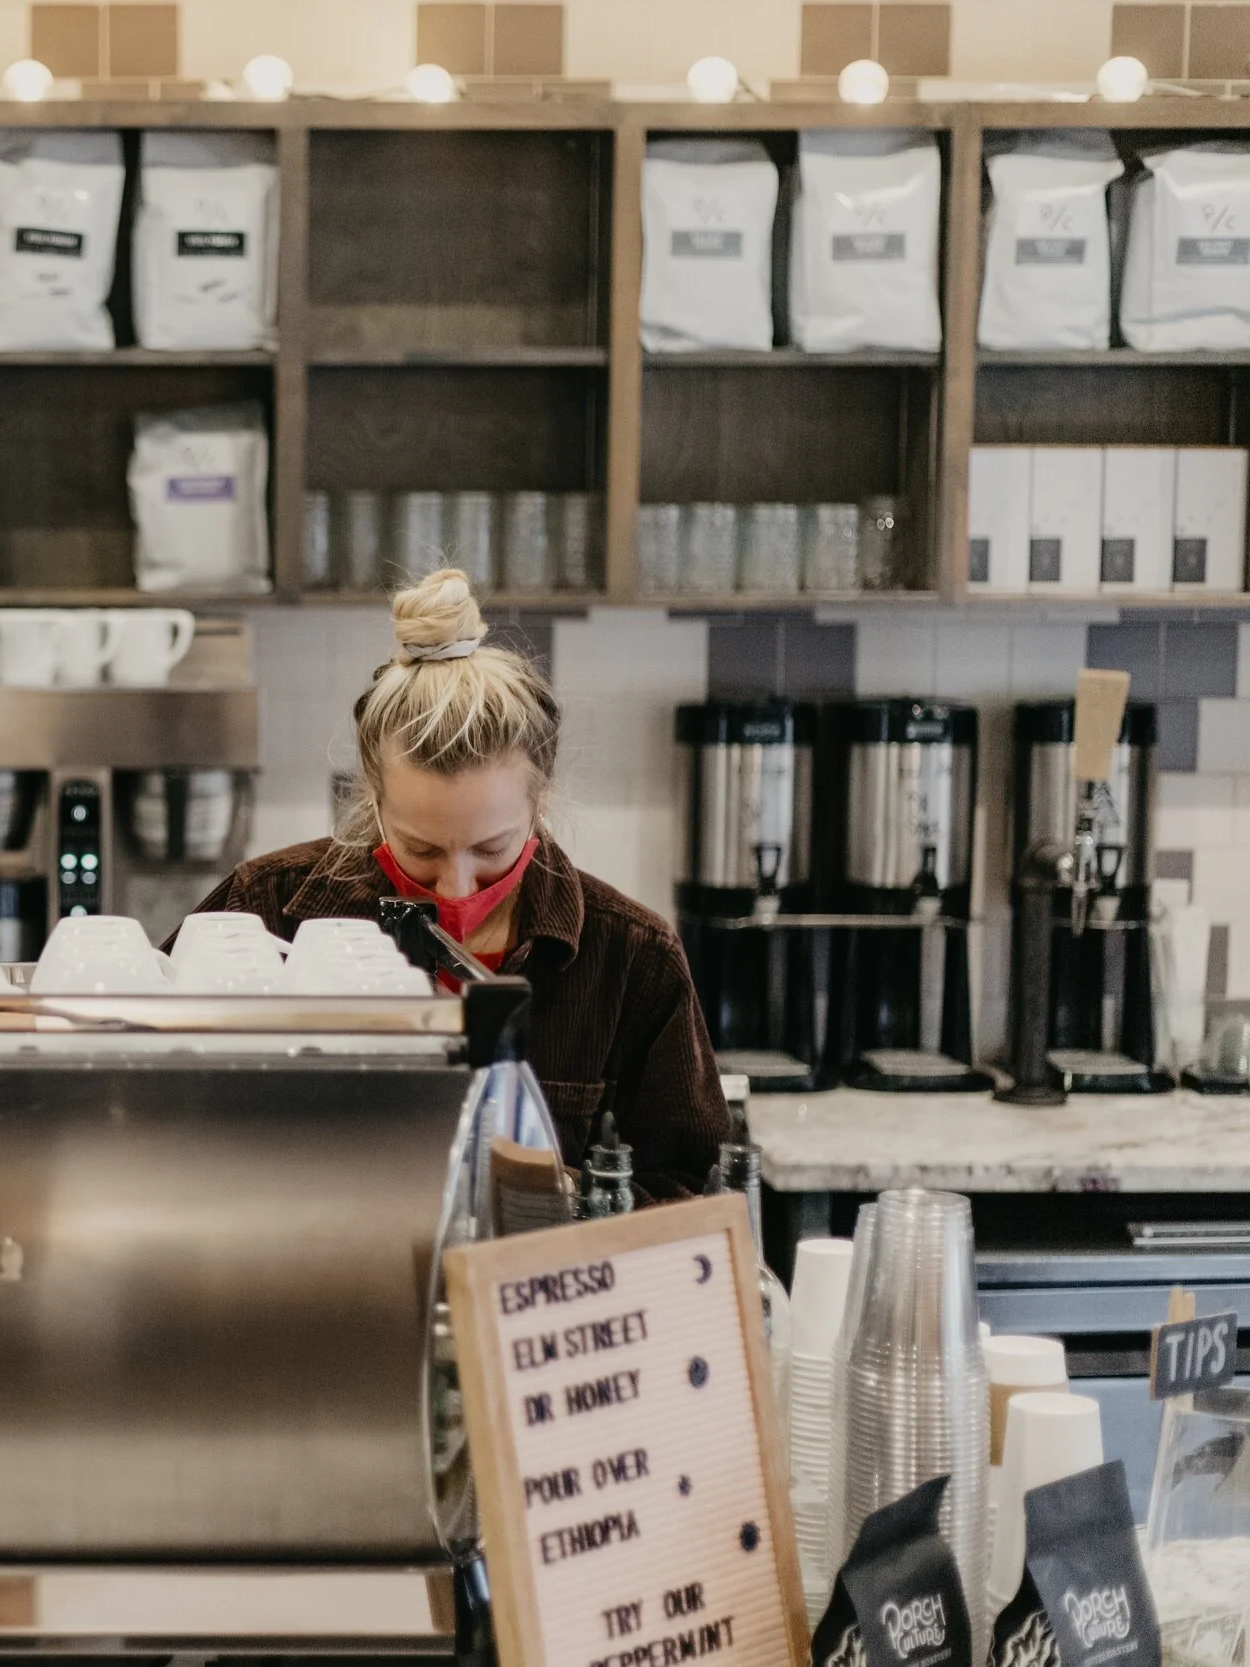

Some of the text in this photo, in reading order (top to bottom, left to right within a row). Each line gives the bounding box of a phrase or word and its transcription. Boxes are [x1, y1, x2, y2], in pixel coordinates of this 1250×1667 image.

[499, 1260, 616, 1315] ESPRESSO
[511, 1309, 648, 1371] ELM STREET
[1165, 1321, 1230, 1382] TIPS
[523, 1369, 642, 1427] DR HONEY
[523, 1448, 650, 1510] POUR OVER
[539, 1508, 641, 1566] ETHIOPIA
[601, 1580, 707, 1640] TRY OUR
[882, 1593, 946, 1650] PORCH
[1064, 1587, 1130, 1637] PORCH
[588, 1614, 735, 1667] PPERMINT
[895, 1622, 946, 1660] CULTURE
